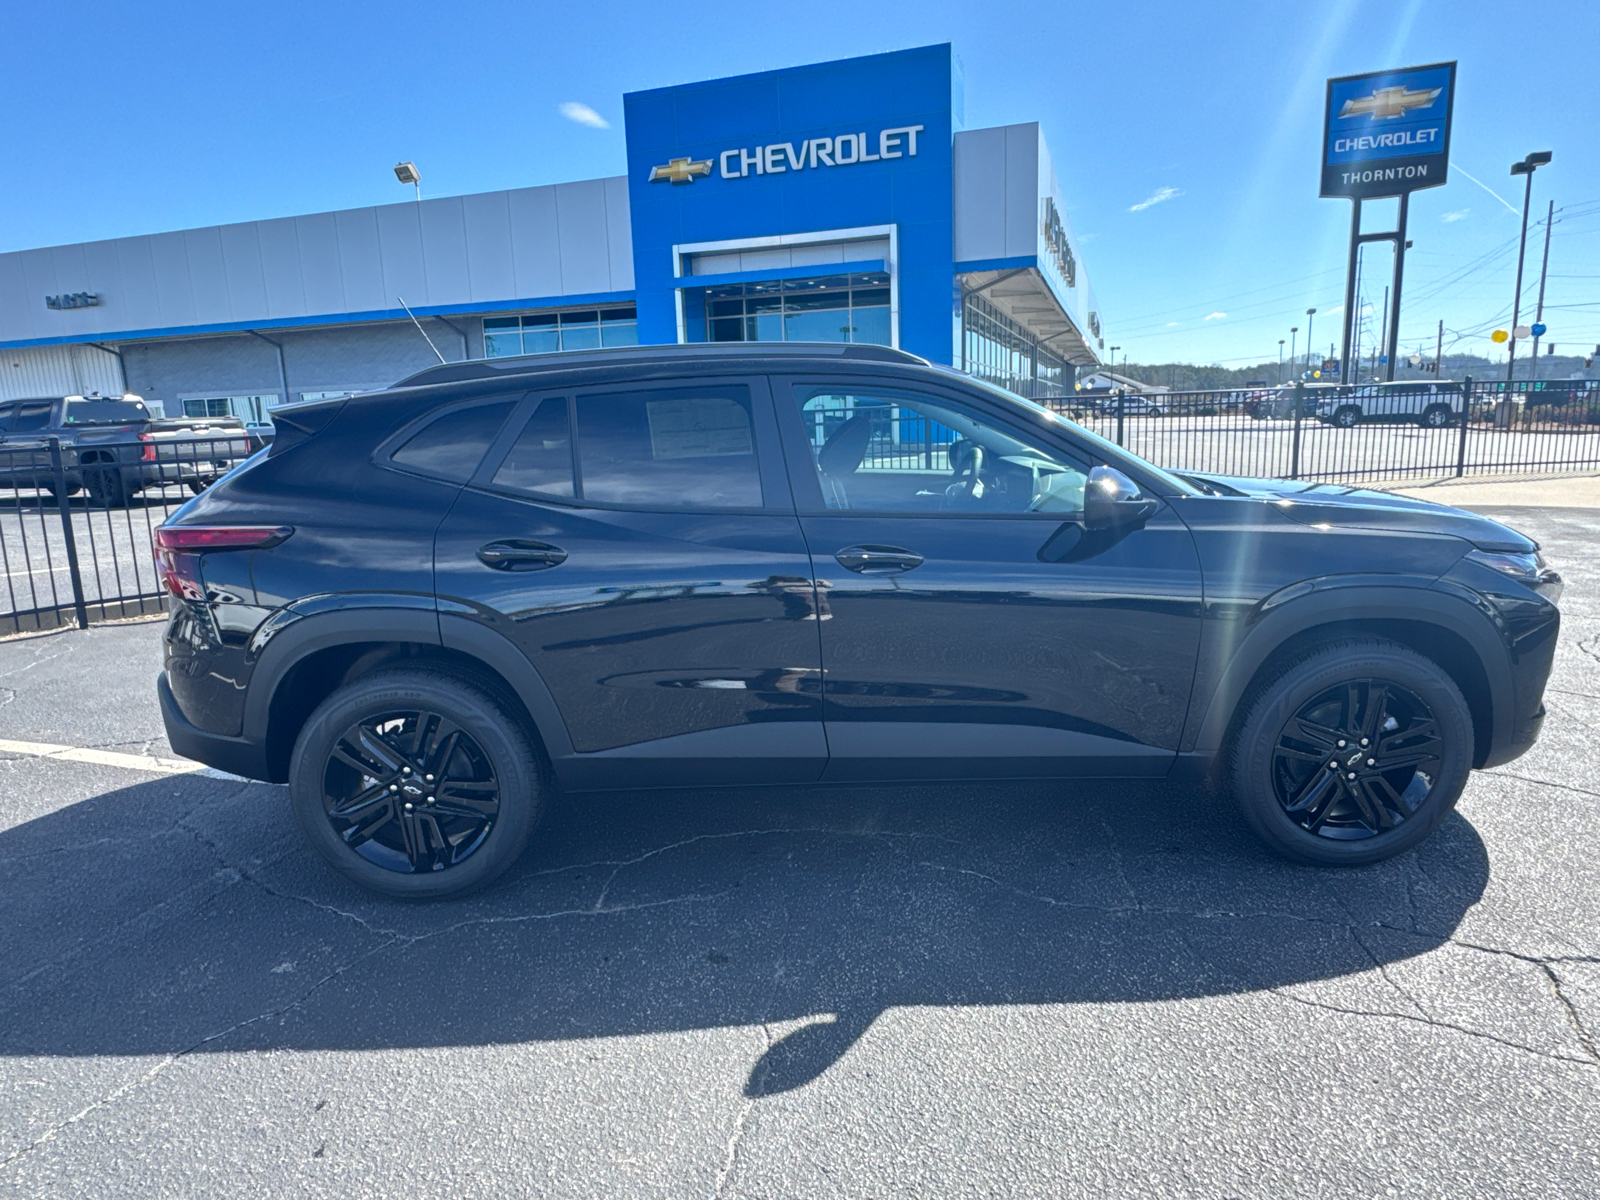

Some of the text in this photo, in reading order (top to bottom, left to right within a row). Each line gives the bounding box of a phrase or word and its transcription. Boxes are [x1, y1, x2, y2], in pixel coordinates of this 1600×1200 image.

[720, 125, 924, 179] CHEVROLET
[1334, 128, 1439, 153] CHEVROLET
[1341, 165, 1428, 185] THORNTON
